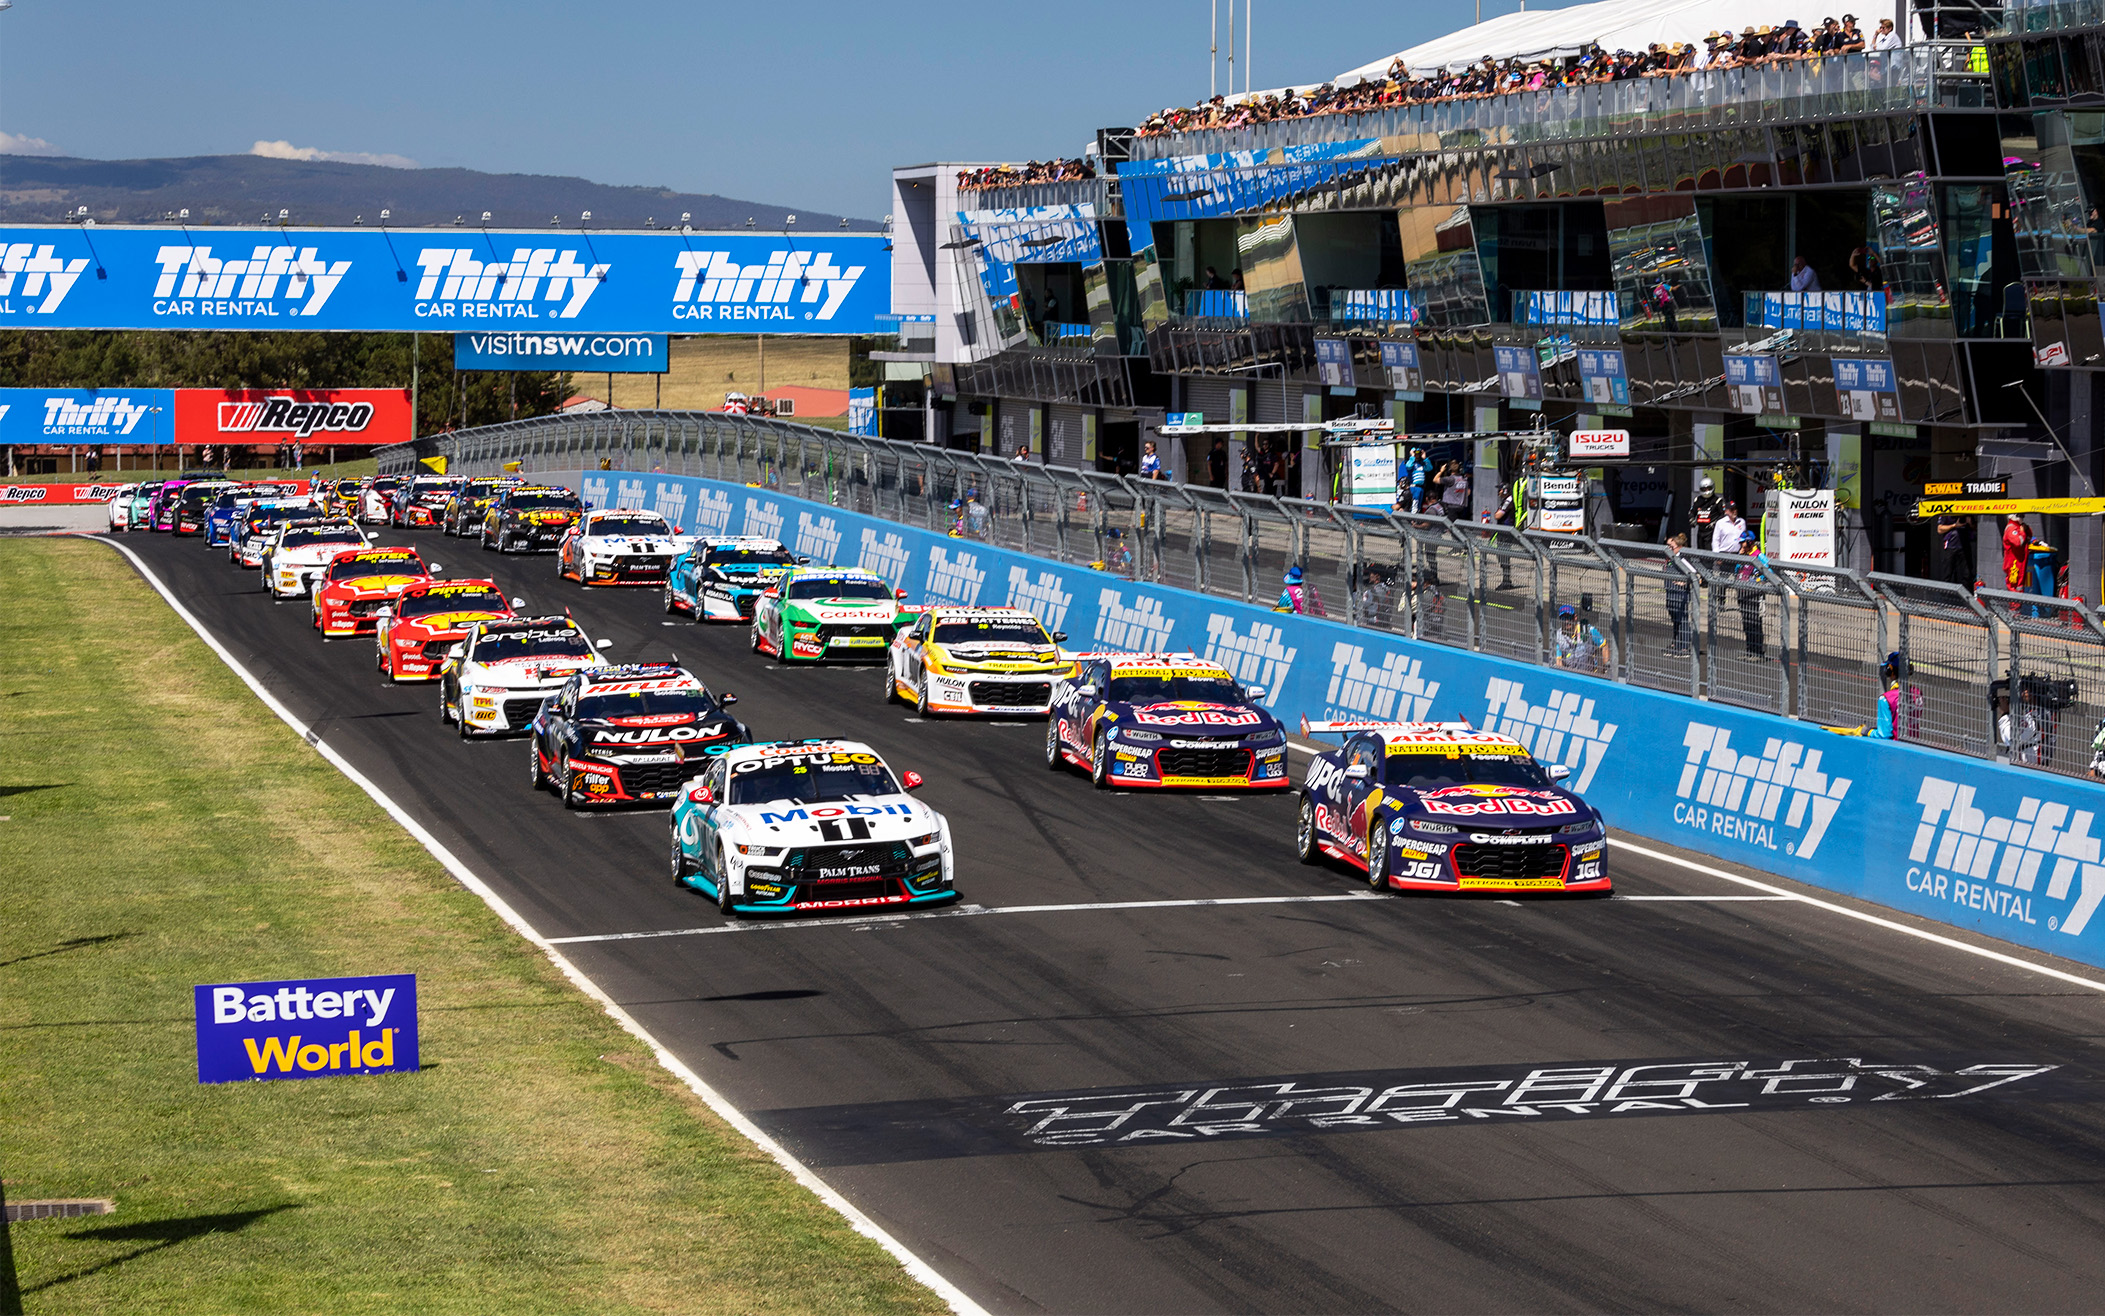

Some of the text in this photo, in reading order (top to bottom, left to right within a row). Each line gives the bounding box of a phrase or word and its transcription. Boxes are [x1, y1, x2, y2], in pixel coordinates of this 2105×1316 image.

[154, 245, 352, 316] Thrifty
[415, 248, 611, 318] Thrifty
[673, 250, 866, 320] Thrifty
[153, 301, 279, 316] CAR RENTAL
[414, 303, 539, 318] CAR RENTAL
[672, 305, 795, 320] CAR RENTAL
[470, 333, 653, 356] visitnsw.com
[43, 397, 148, 435] Thrifty
[257, 396, 373, 438] Repco
[43, 426, 109, 435] CAR RENTAL
[1576, 434, 1623, 443] ISUZU
[1966, 482, 2000, 493] TRADIE
[1790, 500, 1828, 509] NULON
[1926, 504, 1954, 513] JAX
[796, 511, 842, 565] Thrifty
[355, 552, 409, 562] PIRTEK
[858, 528, 910, 594] Thrifty
[846, 573, 881, 581] STEEL
[926, 545, 986, 606] Thrifty
[428, 585, 490, 596] PIRTEK
[1006, 565, 1073, 633] Thrifty
[820, 611, 890, 619] Castrol
[1094, 588, 1176, 654] Thrifty
[481, 629, 576, 643] erebus
[793, 642, 823, 654] RYCO
[1206, 613, 1298, 708] Thrifty
[1114, 669, 1171, 677] NATIONAL
[587, 680, 693, 694] HIFLEX
[936, 676, 965, 688] NULON
[1326, 641, 1440, 722] Thrifty
[1133, 712, 1262, 726] Red Bull
[594, 724, 723, 743] NULON
[1391, 734, 1514, 743] AMPOL
[1483, 676, 1618, 794] Thrifty
[759, 745, 844, 756] Coates
[1108, 741, 1153, 759] SUPERCHEAP
[1390, 745, 1455, 753] NATIONAL
[1470, 753, 1510, 762] Feeney
[793, 764, 855, 774] 25 Mostert
[585, 773, 610, 784] filter
[589, 783, 609, 794] app
[1676, 721, 1852, 859] Thrifty
[760, 804, 912, 824] Mobil
[1420, 798, 1577, 816] Red Bull
[1673, 802, 1778, 850] CAR RENTAL
[1391, 835, 1448, 856] SUPERCHEAP
[1470, 833, 1552, 845] COMPLETE
[1404, 849, 1426, 858] AUTO
[1908, 776, 2105, 936] Thrifty
[820, 865, 880, 878] PALM TRANS
[1401, 860, 1441, 879] JGI
[1575, 861, 1600, 880] JGI
[1463, 879, 1513, 887] NATIONAL
[799, 896, 903, 909] MORRIS
[1905, 866, 2037, 925] CAR RENTAL
[213, 986, 395, 1026] Battery
[243, 1028, 394, 1074] World
[1003, 1059, 2062, 1130] Thrifty
[1313, 1101, 1750, 1130] RENTAL
